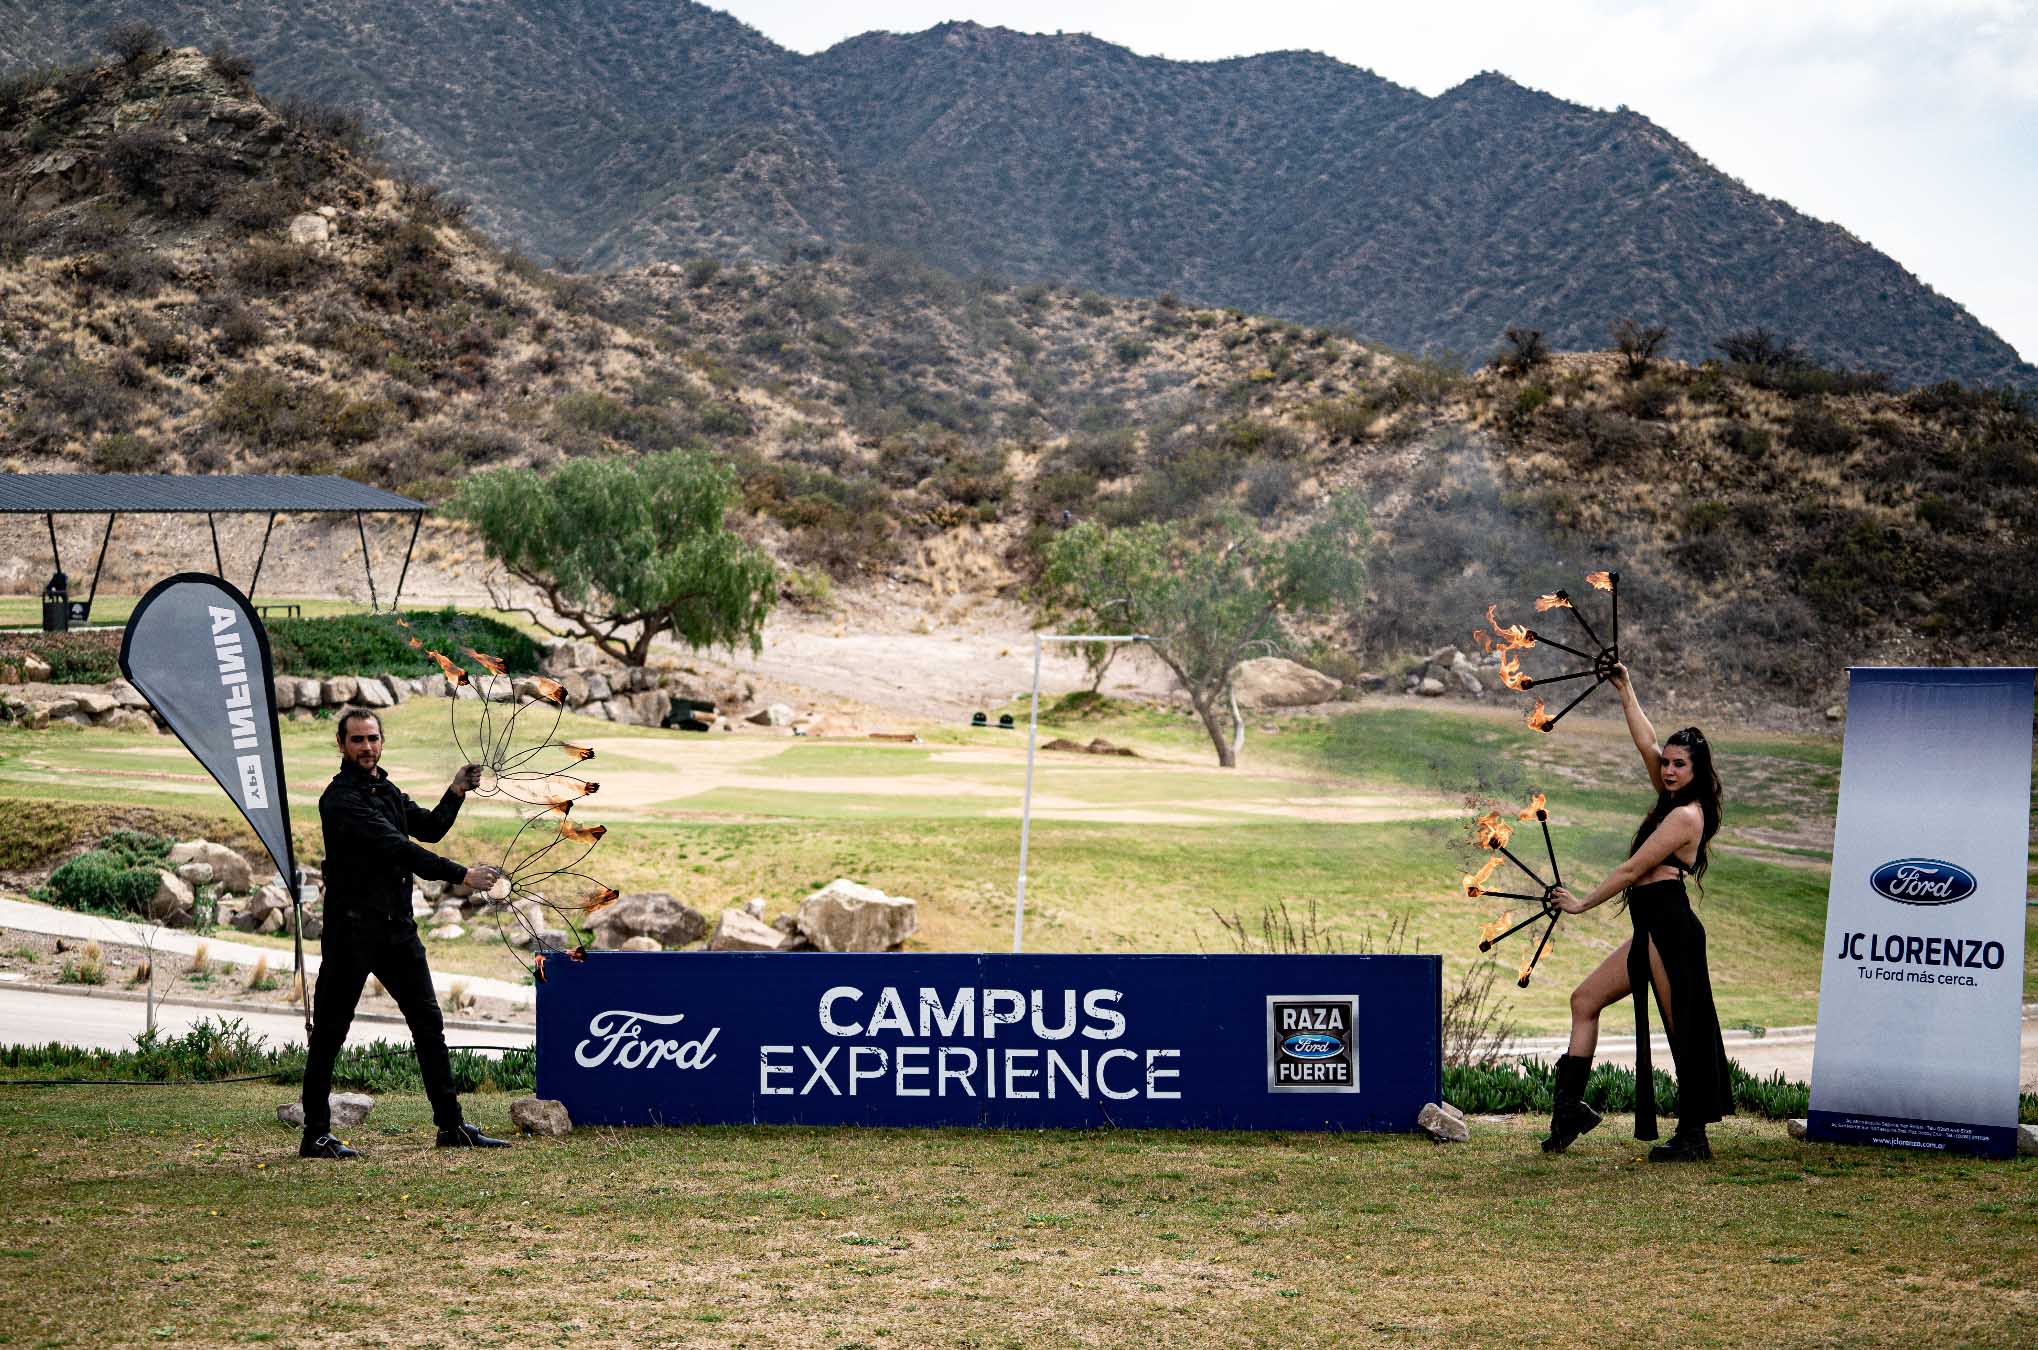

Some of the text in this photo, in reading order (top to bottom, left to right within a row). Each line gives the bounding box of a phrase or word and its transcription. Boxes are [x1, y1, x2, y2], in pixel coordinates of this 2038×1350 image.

[1889, 865, 1955, 898] Ford
[1838, 932, 2005, 970] JC LORENZO
[1858, 966, 1979, 987] Tu Ford más cerca.
[818, 985, 1127, 1041] CAMPUS
[1283, 1007, 1344, 1030] RAZA
[574, 1010, 721, 1070] Ford
[1295, 1037, 1331, 1053] Ford
[759, 1045, 1182, 1100] EXPERIENCE
[1280, 1063, 1347, 1081] FUERTE
